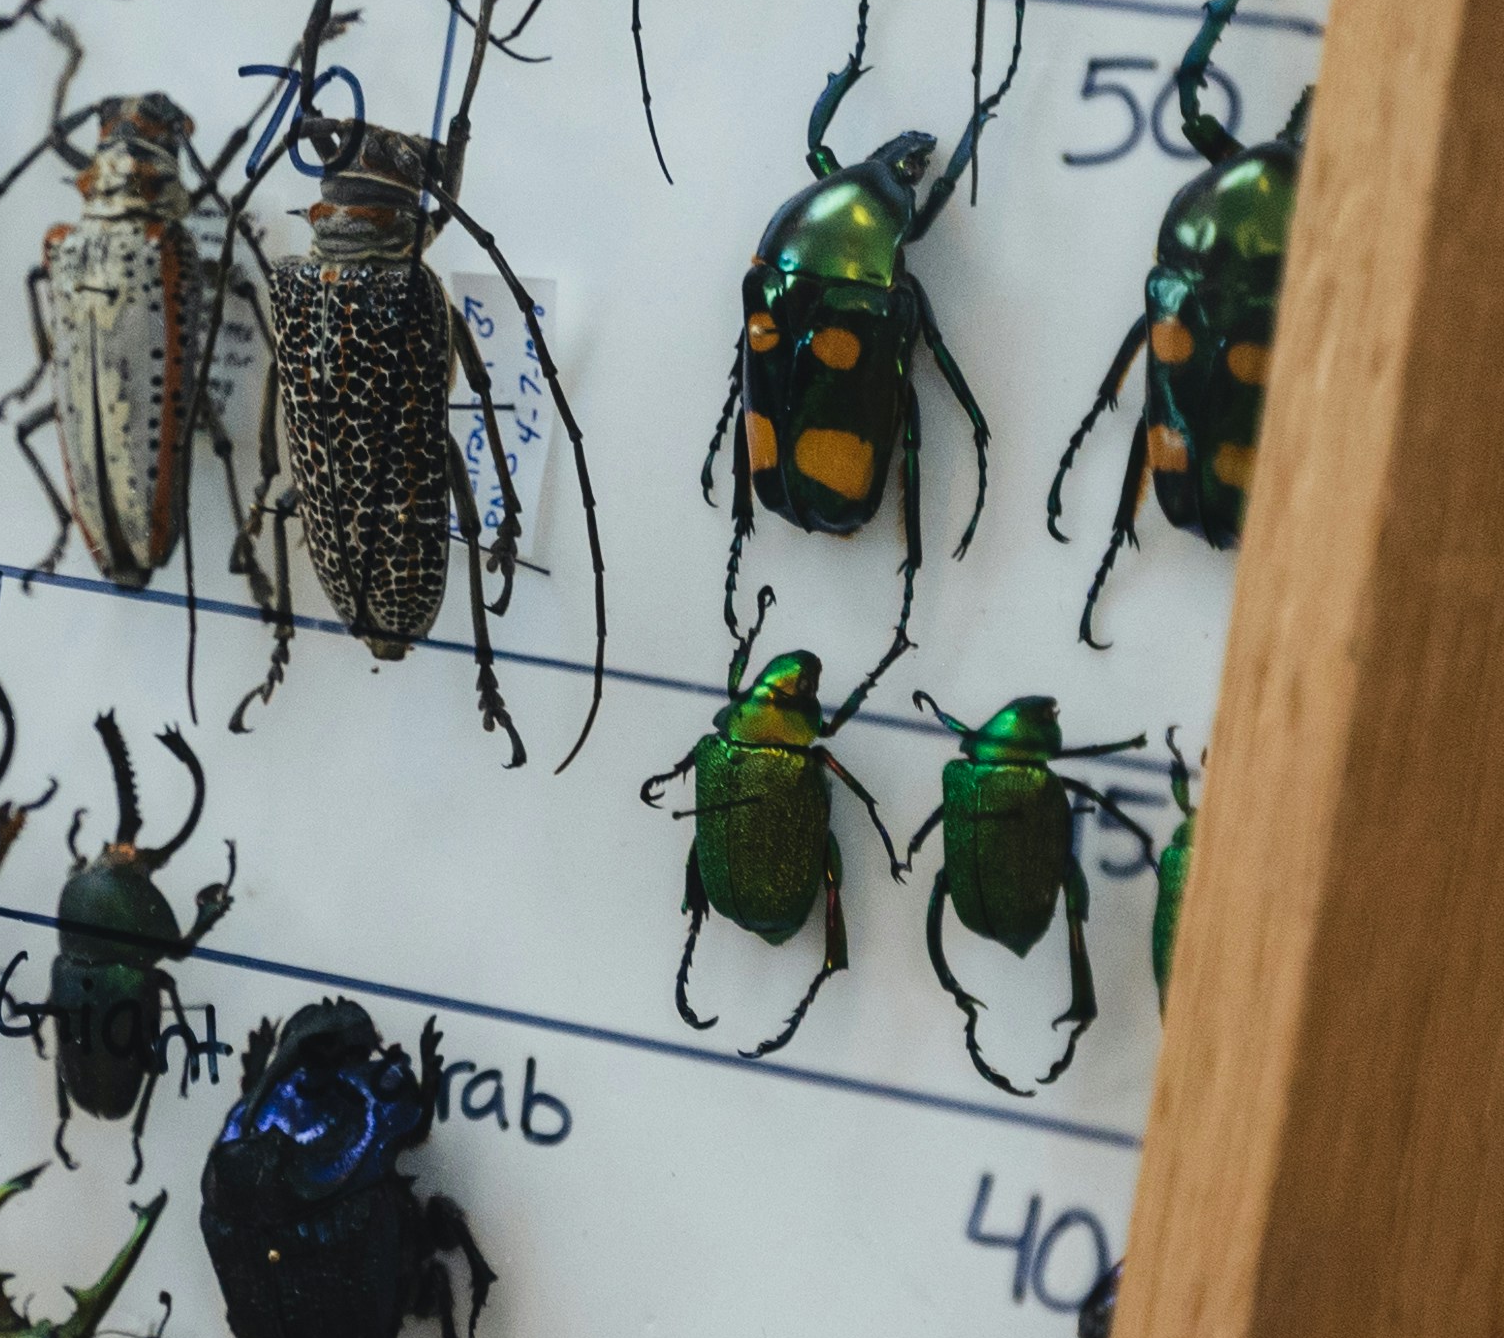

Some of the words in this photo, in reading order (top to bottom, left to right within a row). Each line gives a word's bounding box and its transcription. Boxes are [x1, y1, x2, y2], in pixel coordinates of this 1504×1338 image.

[238, 63, 365, 178] 70
[1061, 57, 1243, 167] 50
[966, 1172, 1114, 1313] 40
